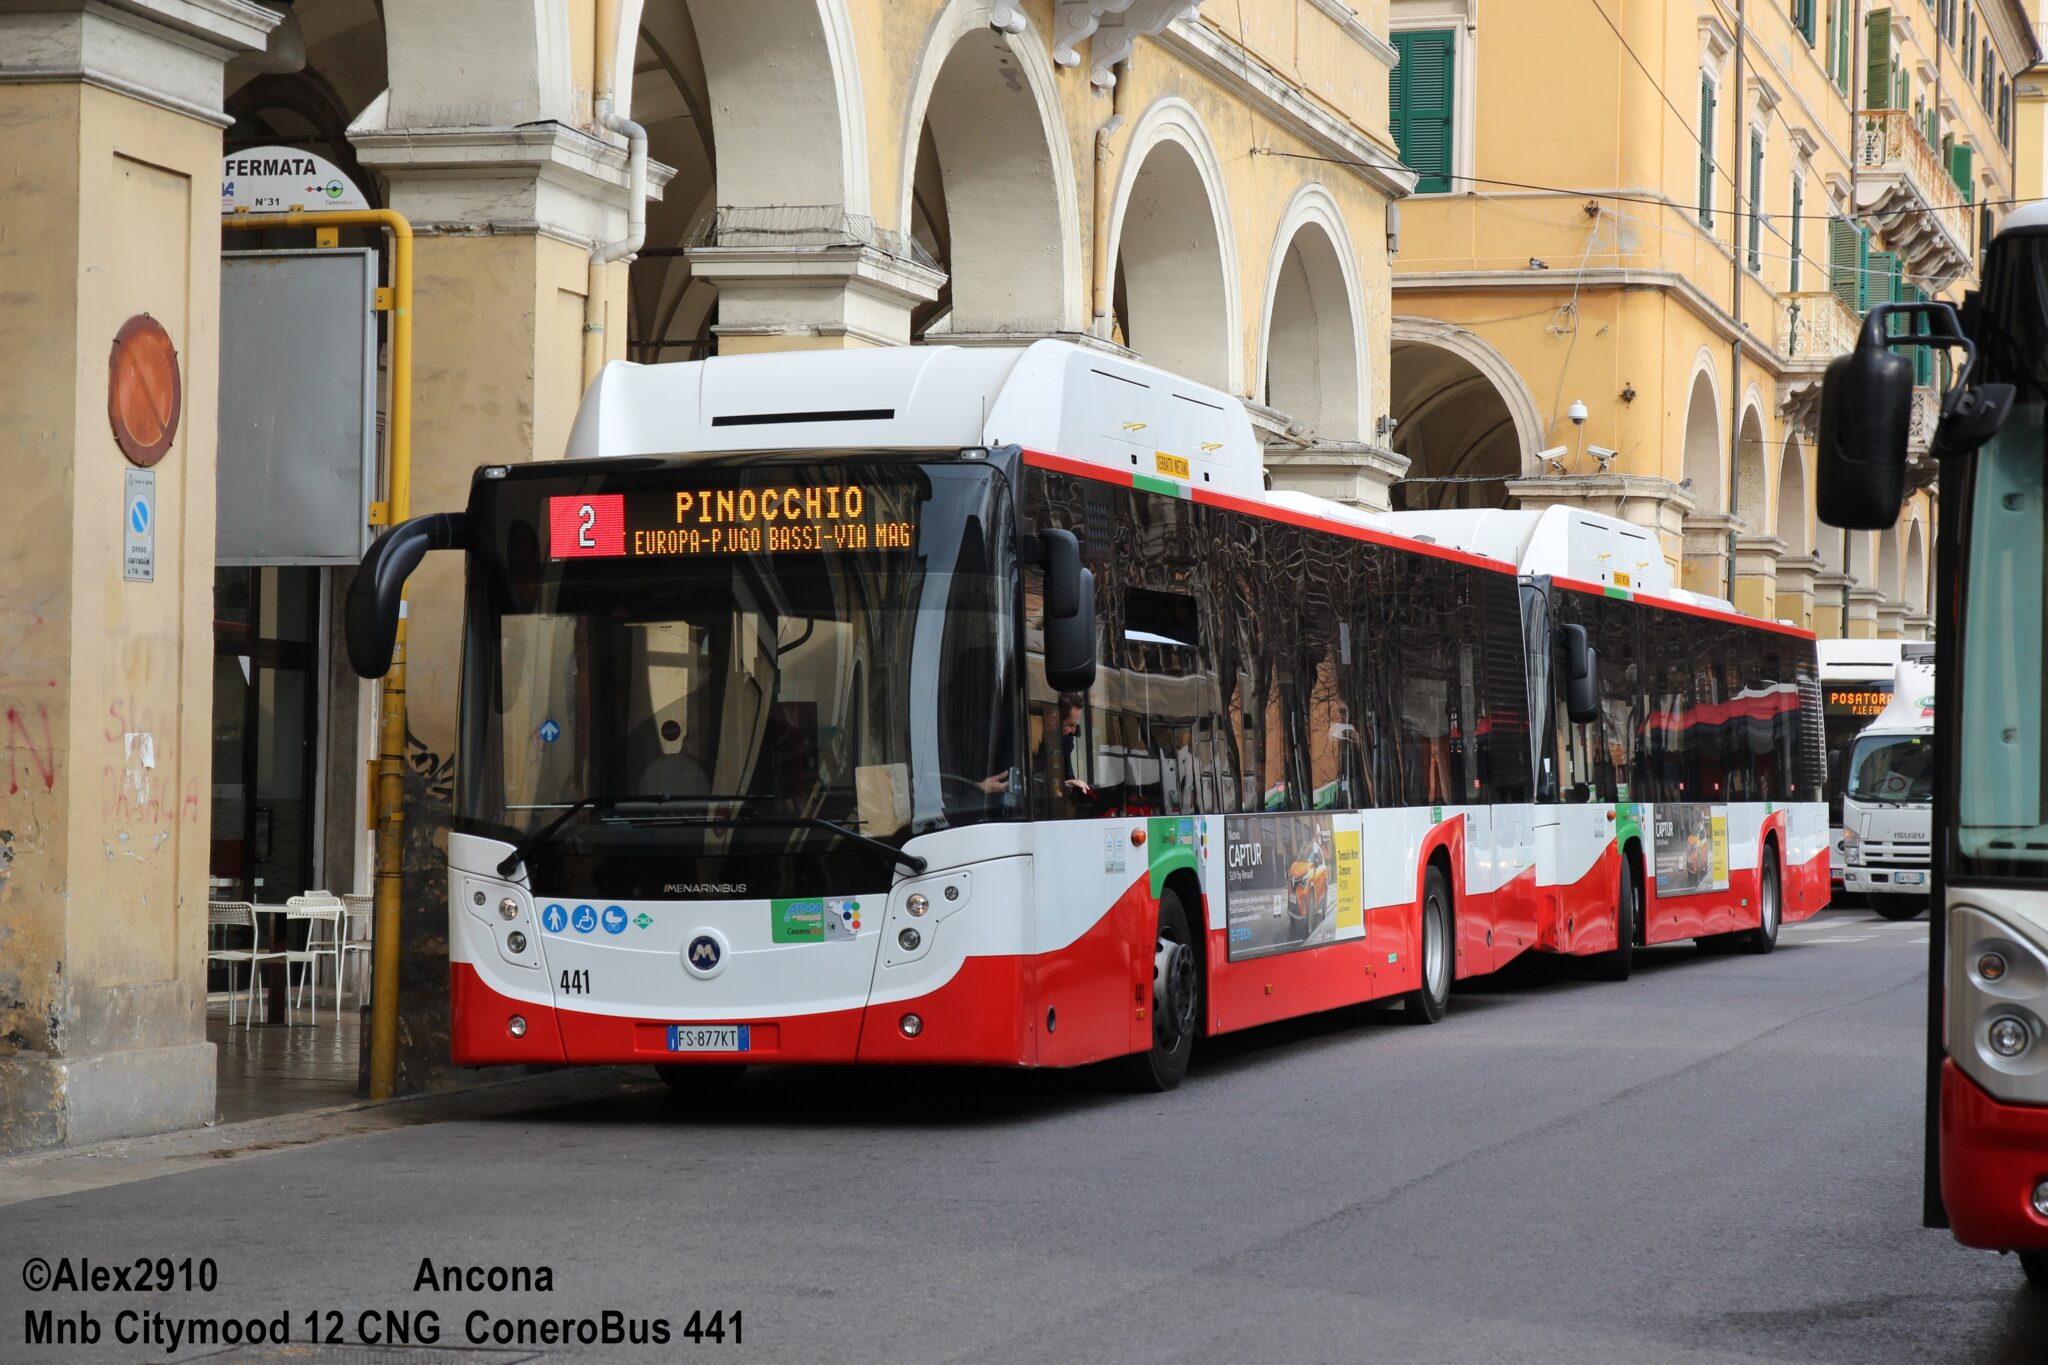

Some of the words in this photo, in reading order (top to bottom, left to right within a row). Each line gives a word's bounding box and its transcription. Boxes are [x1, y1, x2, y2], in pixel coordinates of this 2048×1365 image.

[225, 159, 316, 176] FERMATA
[676, 486, 863, 523] PINOCCHIO
[578, 503, 597, 549] 2
[635, 527, 761, 555] EUROPA-P.UGO
[769, 524, 868, 550] BASSI-VIA
[875, 523, 915, 548] MAG
[1656, 822, 1674, 837] CAPTUR
[1228, 843, 1263, 868] CAPTUR
[560, 969, 590, 994] 441
